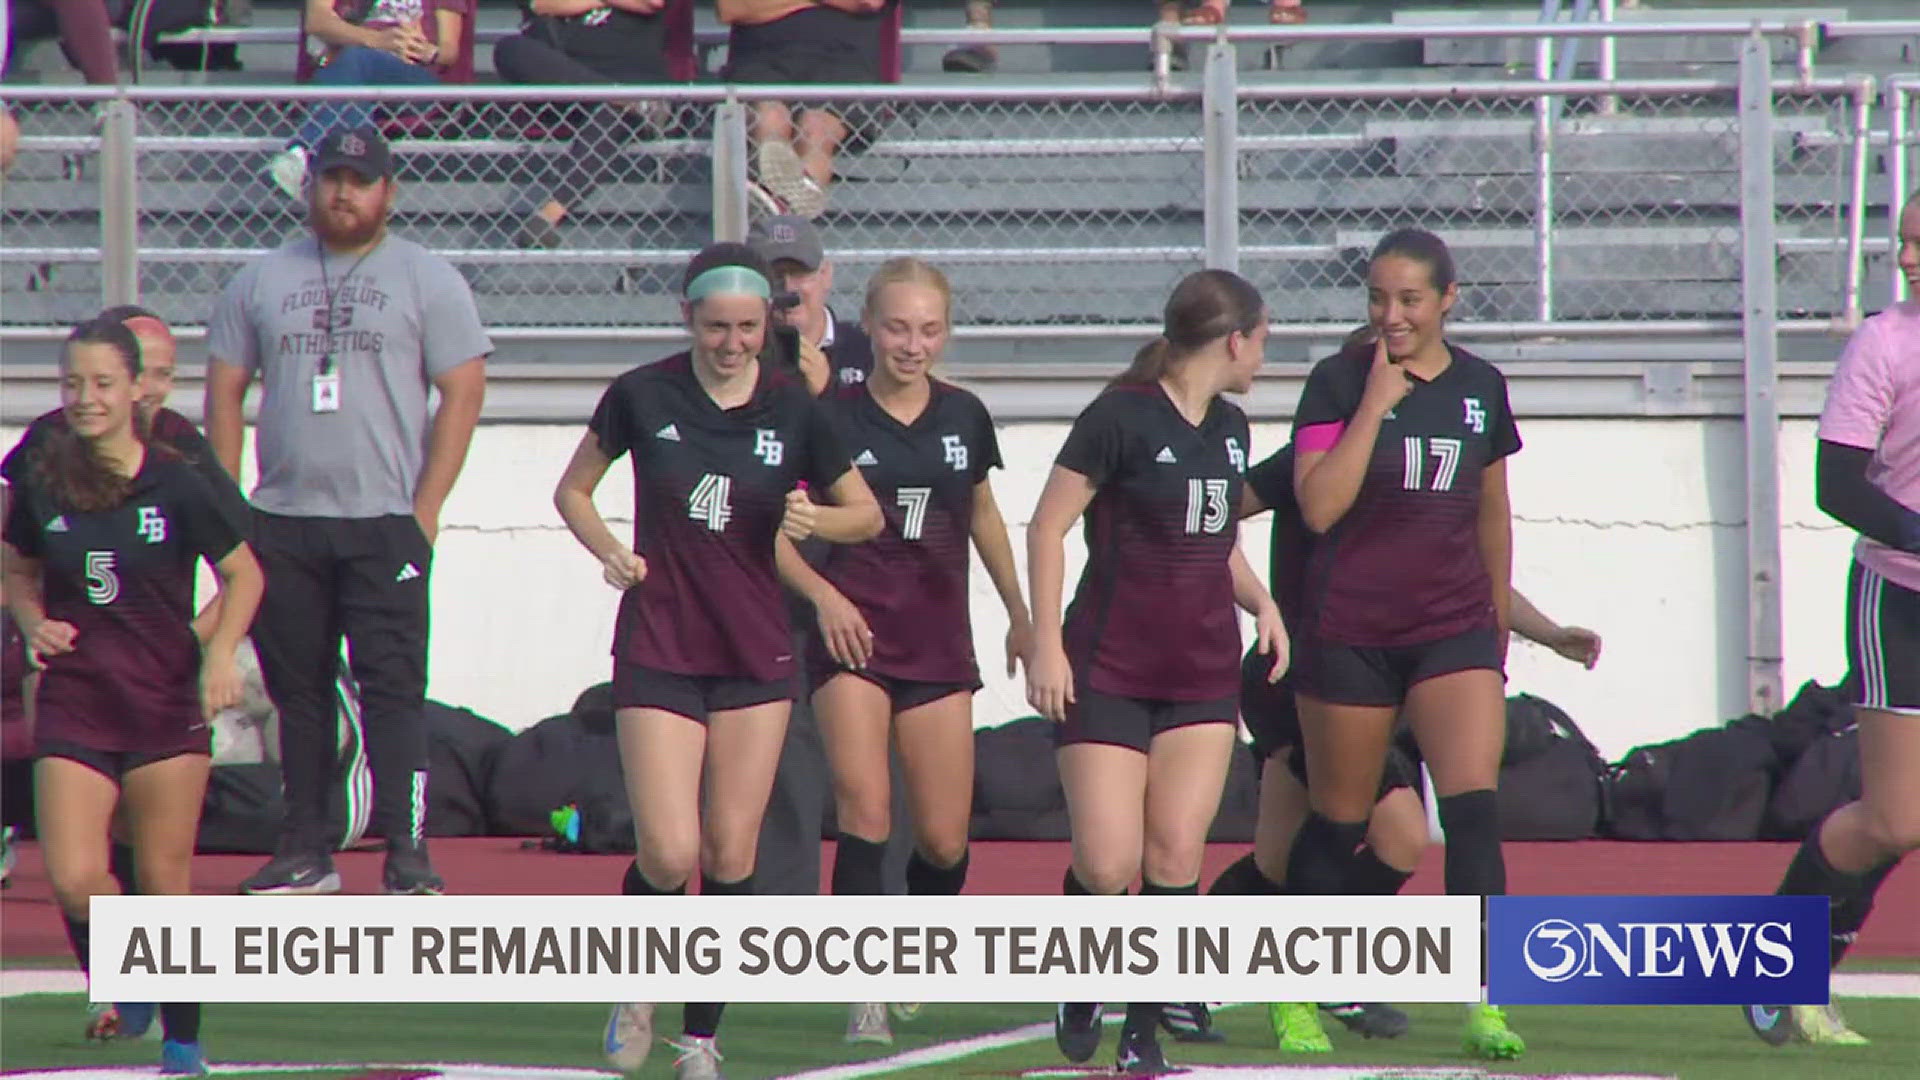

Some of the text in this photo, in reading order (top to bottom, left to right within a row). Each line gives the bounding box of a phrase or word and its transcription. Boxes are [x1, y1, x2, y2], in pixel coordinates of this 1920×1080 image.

[340, 285, 392, 312] BLUFF
[279, 330, 385, 355] ATHLETICS
[1463, 397, 1487, 434] FB
[755, 429, 784, 466] FB
[941, 434, 968, 472] FB
[1403, 436, 1462, 492] 17
[688, 472, 733, 533] 4
[897, 487, 932, 540] 7
[1185, 478, 1229, 534] 13
[137, 506, 168, 544] FB
[85, 551, 119, 605] 5
